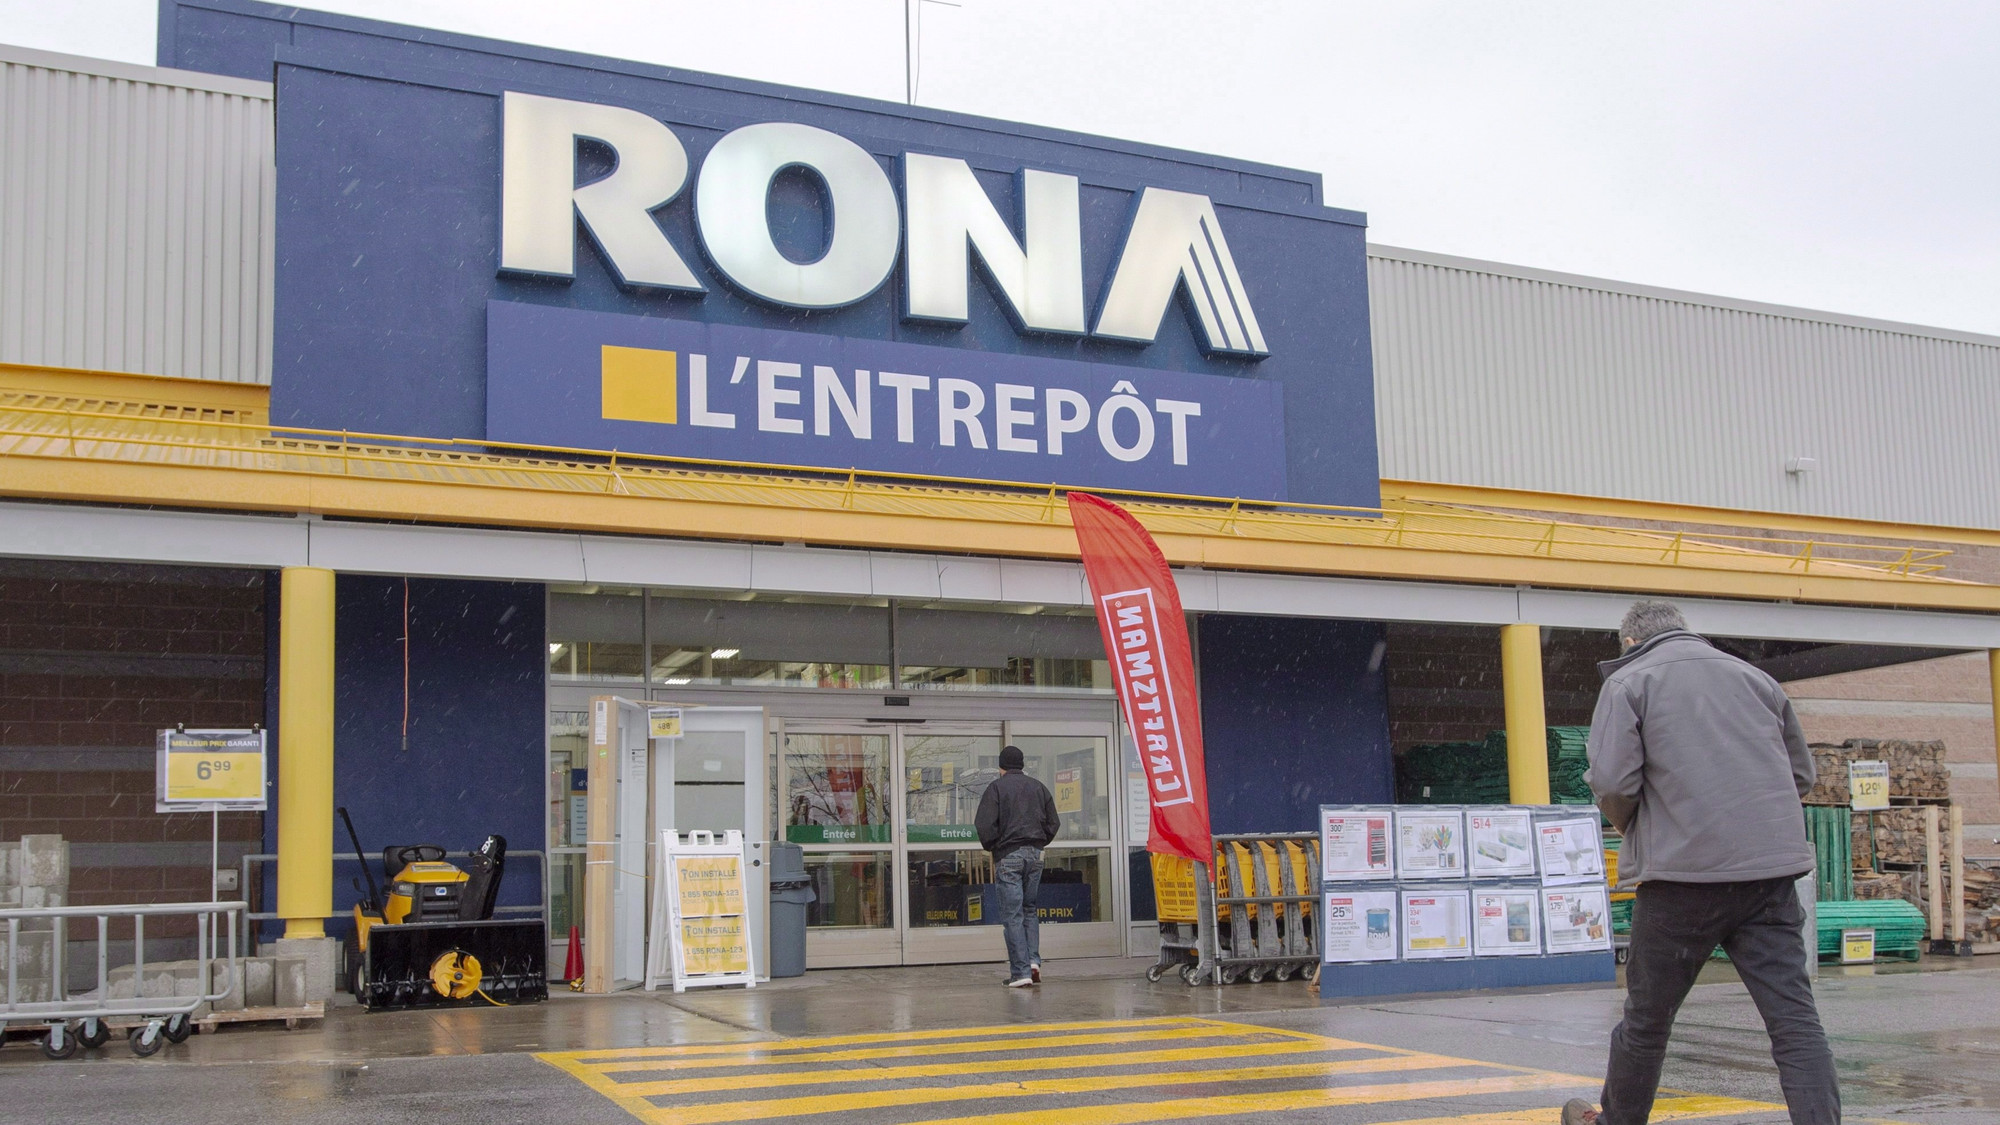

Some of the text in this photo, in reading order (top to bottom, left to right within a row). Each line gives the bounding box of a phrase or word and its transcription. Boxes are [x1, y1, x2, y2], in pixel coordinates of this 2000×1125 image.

[499, 90, 1270, 358] RONA
[688, 353, 1202, 468] L'ENTREPÔT
[822, 829, 856, 839] Entrée
[940, 827, 972, 838] Entrée
[688, 869, 737, 878] ON INSTALLE
[702, 889, 739, 897] RONA-123
[1049, 907, 1074, 918] PRIX
[692, 925, 741, 935] ON INSTALLE
[1368, 931, 1389, 940] RONA
[692, 947, 704, 955] 855
[706, 945, 743, 954] RONA-123
